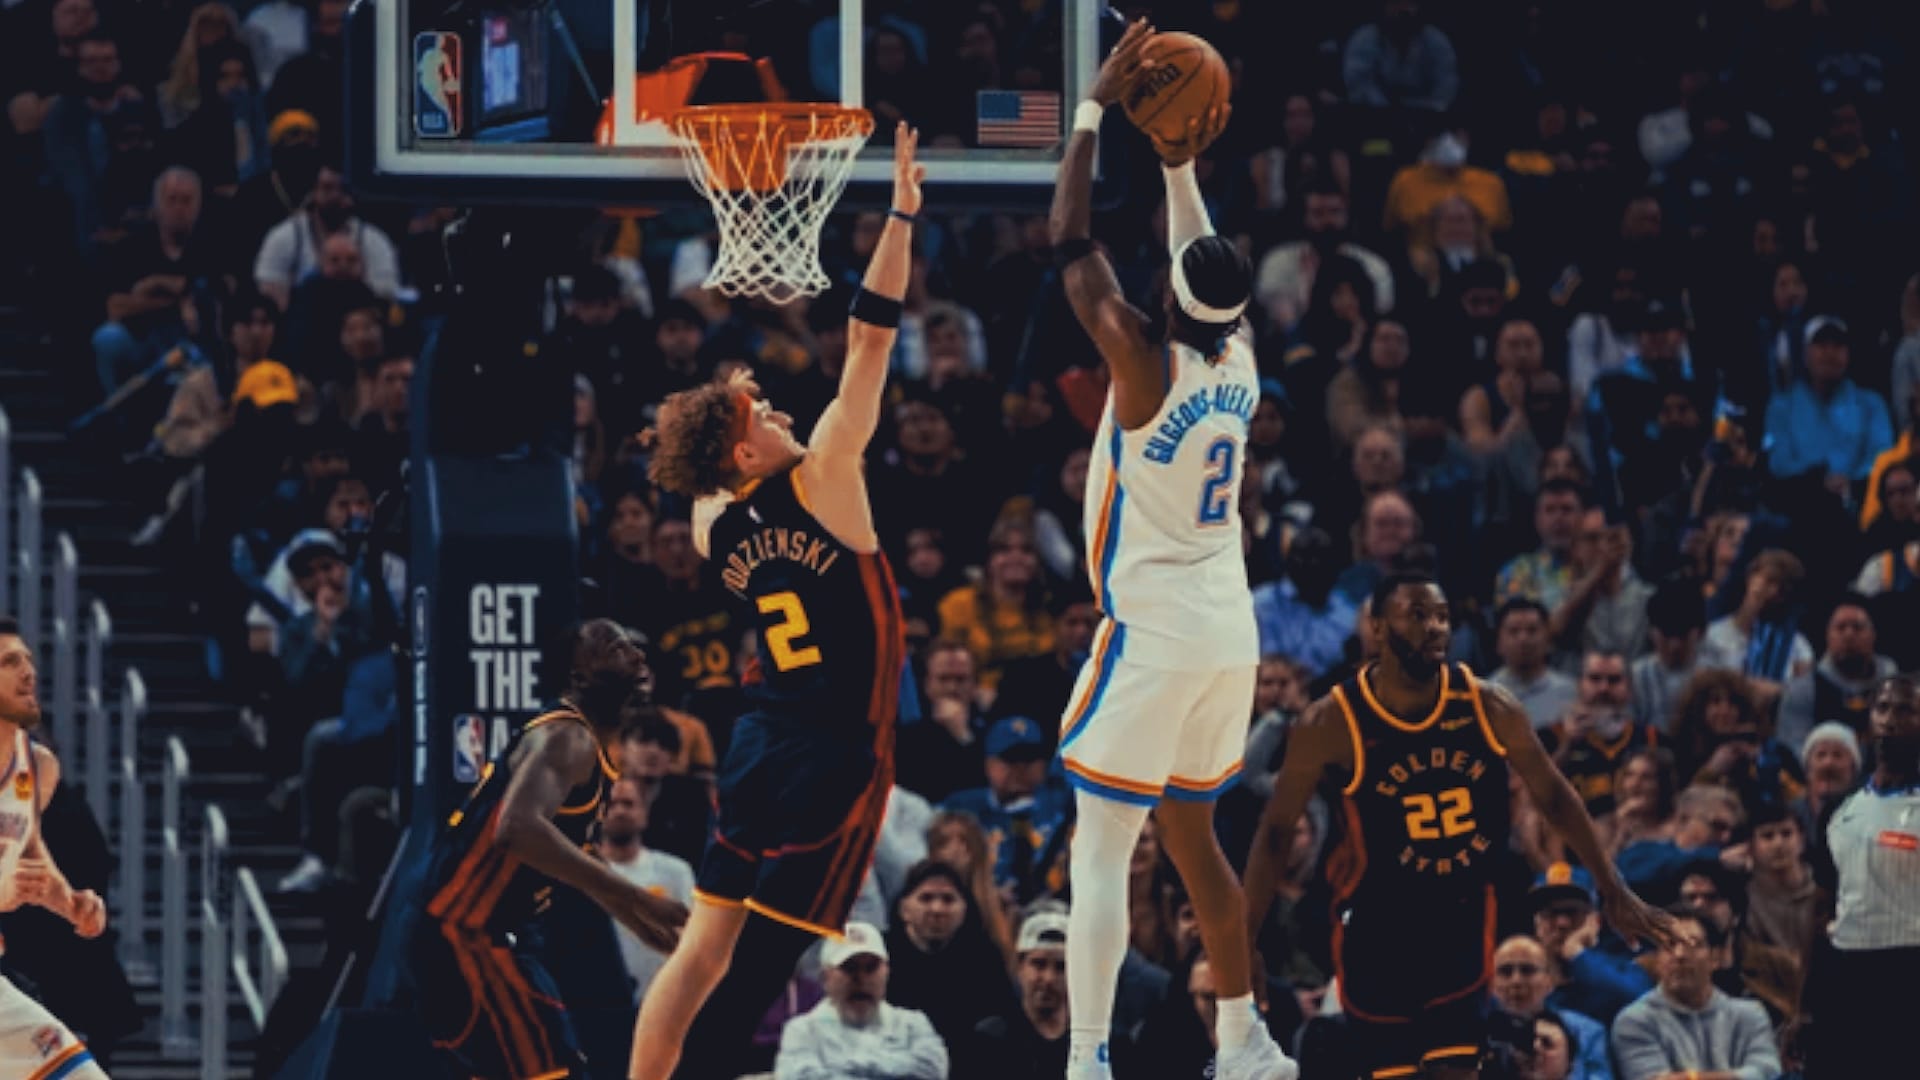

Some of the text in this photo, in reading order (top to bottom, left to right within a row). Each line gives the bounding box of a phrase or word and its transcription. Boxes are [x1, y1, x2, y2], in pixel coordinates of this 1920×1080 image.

[1196, 433, 1238, 527] 2
[469, 583, 541, 645] GET
[756, 589, 823, 673] 2
[469, 650, 542, 711] THE
[1376, 747, 1487, 797] GOLDEN
[1401, 786, 1477, 840] 22
[1398, 833, 1492, 876] STATE
